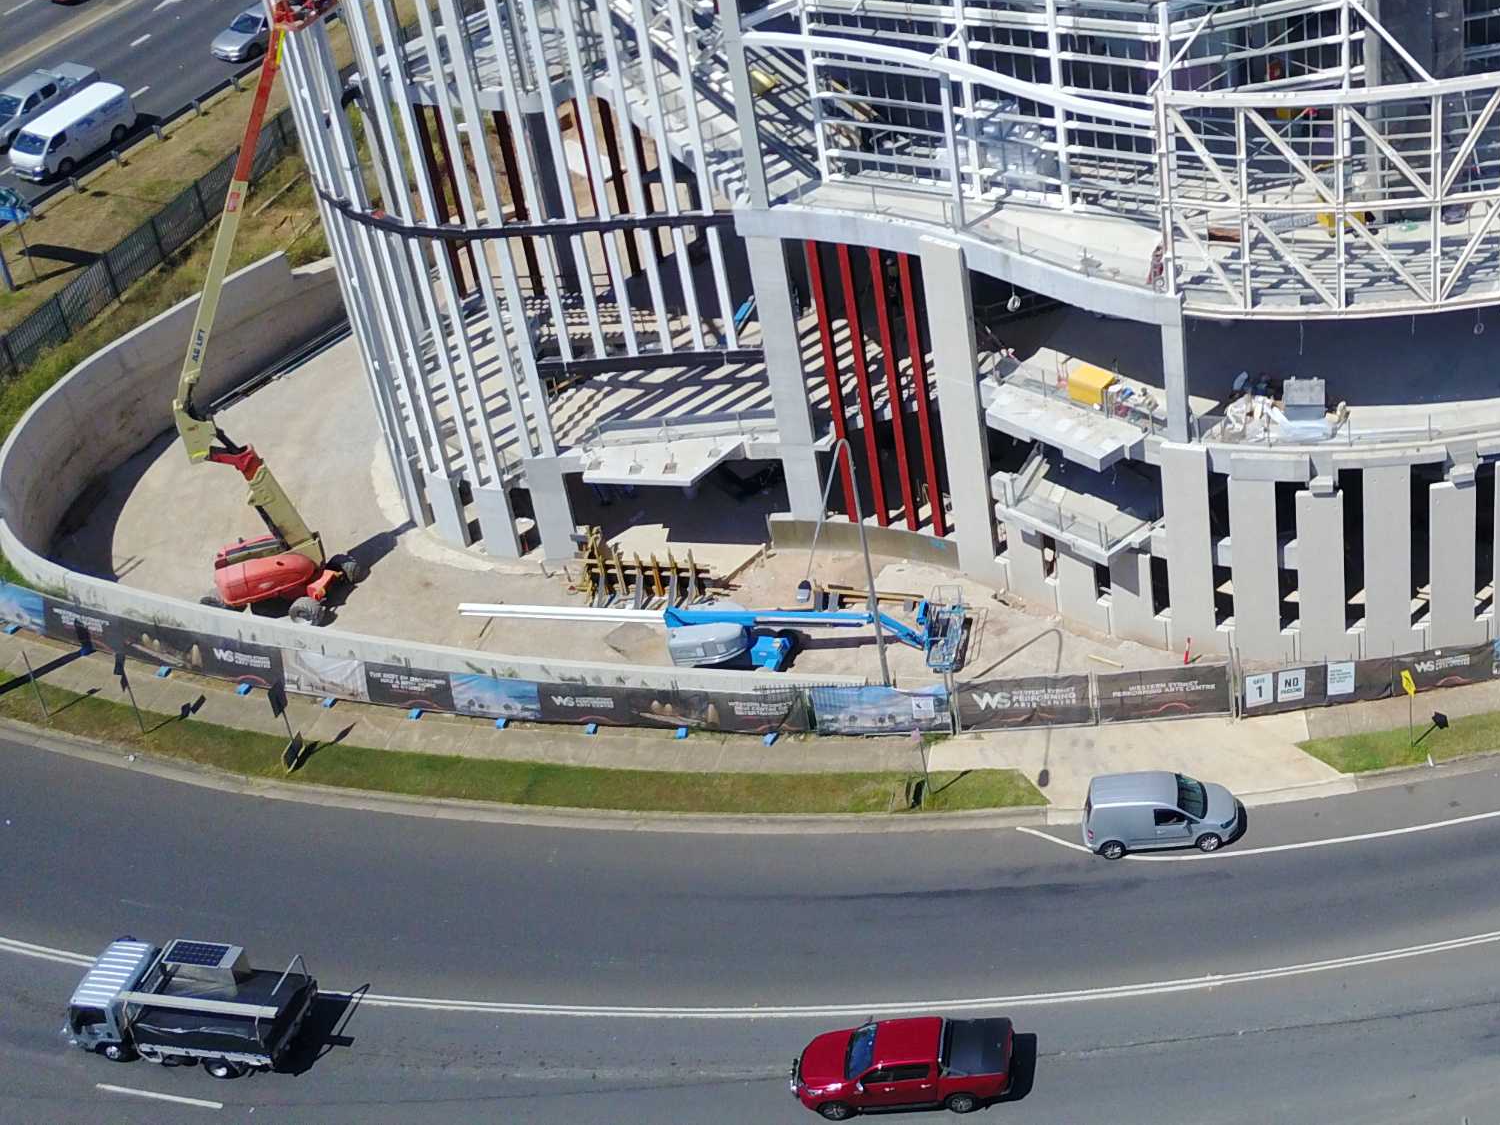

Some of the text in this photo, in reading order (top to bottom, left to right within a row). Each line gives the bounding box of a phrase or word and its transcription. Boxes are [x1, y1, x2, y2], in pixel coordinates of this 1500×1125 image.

[1284, 677, 1299, 688] NO
[1256, 686, 1263, 698] 1
[972, 692, 1011, 710] WS
